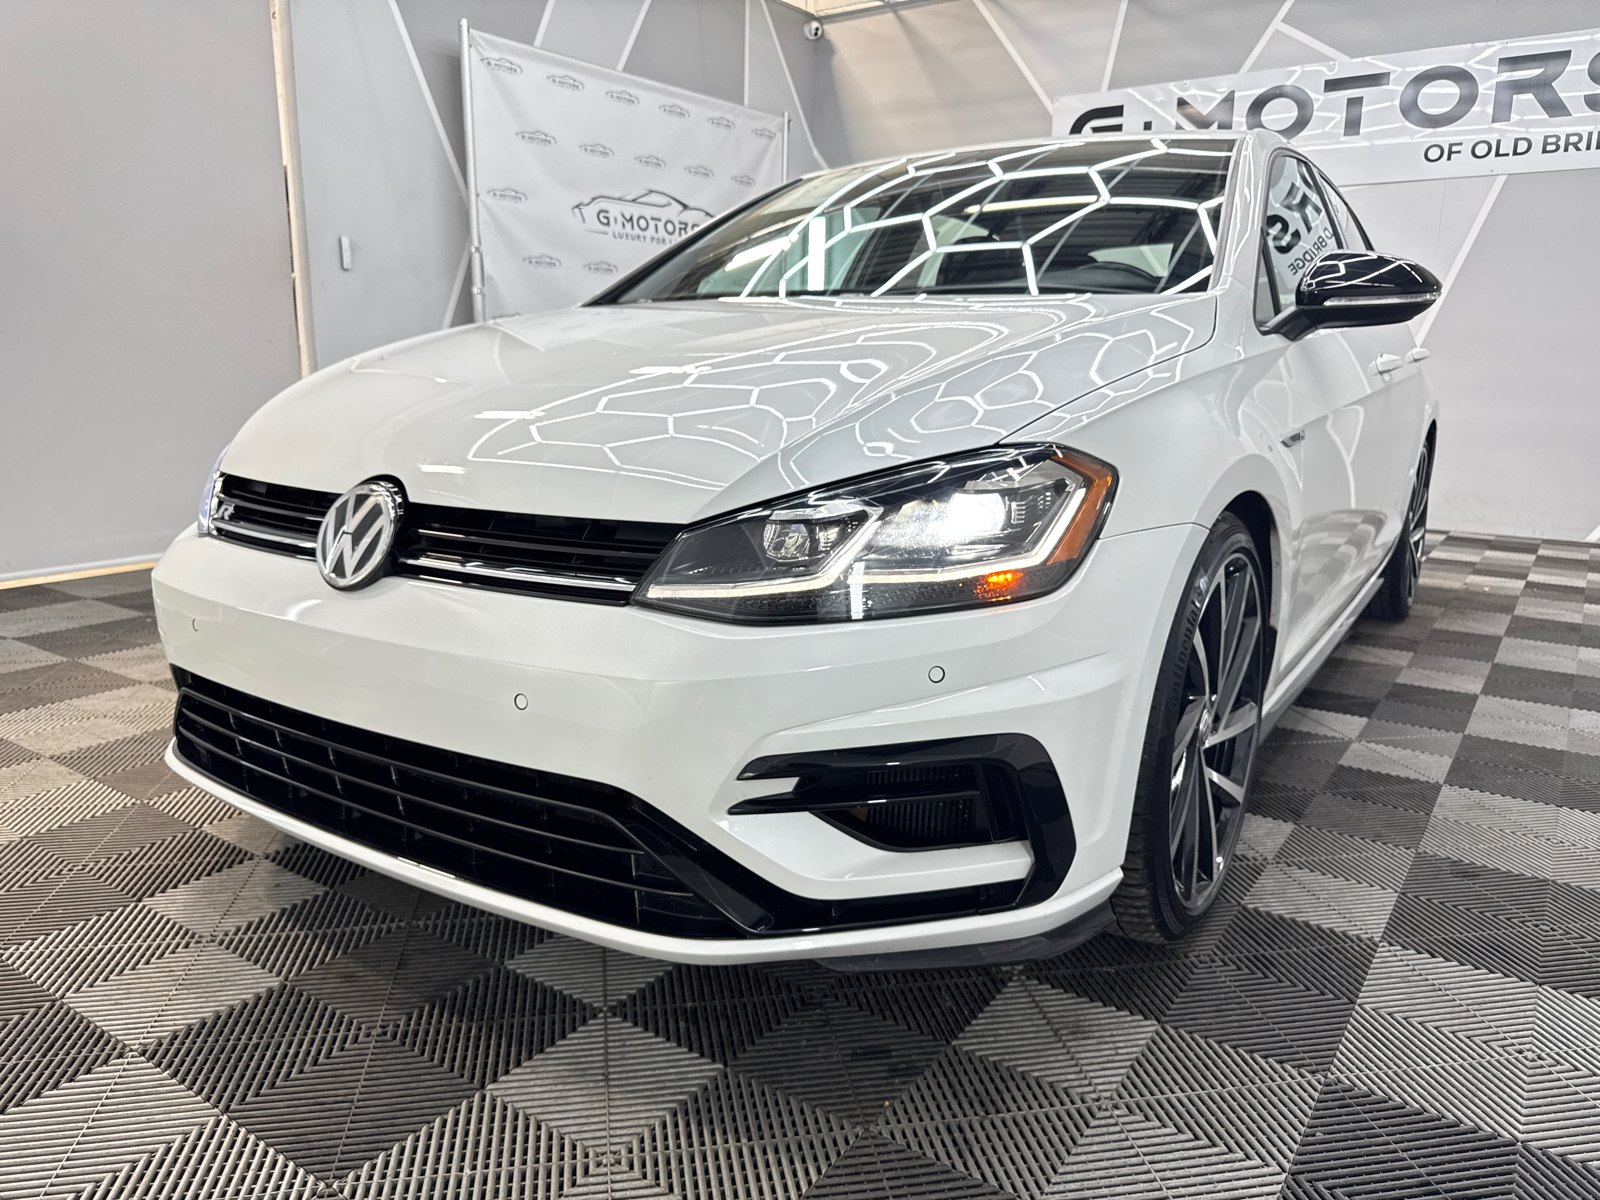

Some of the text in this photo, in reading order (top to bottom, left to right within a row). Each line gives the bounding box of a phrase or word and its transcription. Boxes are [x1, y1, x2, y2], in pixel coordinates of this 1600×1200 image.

[1423, 130, 1600, 163] OF OLD BRI
[612, 231, 647, 243] LUXURY
